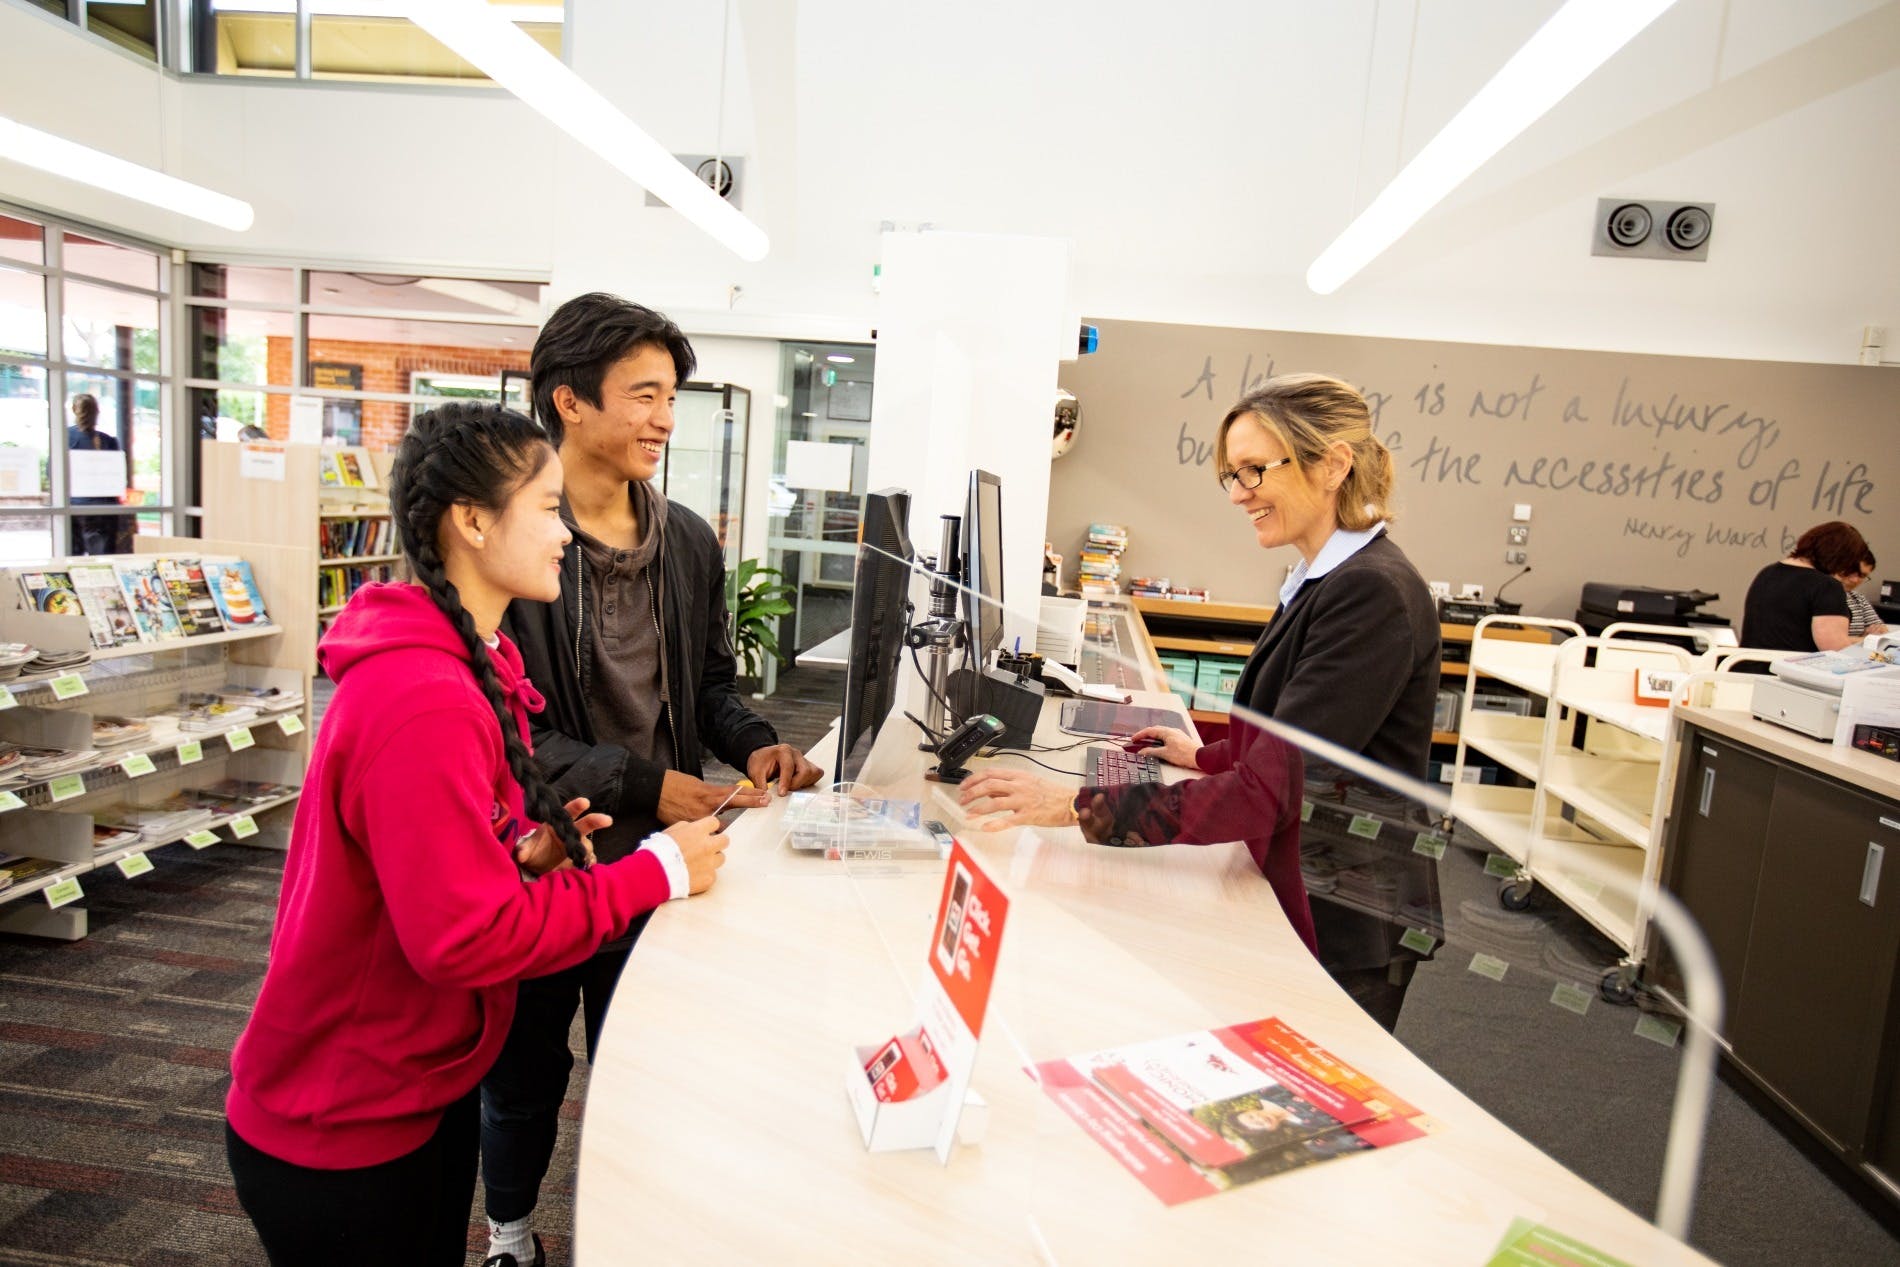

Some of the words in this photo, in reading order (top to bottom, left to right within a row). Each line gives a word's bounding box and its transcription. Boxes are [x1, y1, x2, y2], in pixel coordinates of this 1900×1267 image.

[1180, 355, 1217, 401] A
[1413, 364, 1446, 416] is
[1468, 373, 1546, 422] not
[1562, 396, 1589, 424] a
[1612, 375, 1781, 470] luxury,
[1176, 421, 1215, 467] bu
[1410, 435, 1482, 485] the
[1503, 447, 1725, 504] necessities
[1749, 458, 1801, 511] of
[1811, 459, 1876, 517] life
[1622, 517, 1697, 558] Henry
[1705, 522, 1769, 550] Ward
[845, 849, 892, 861] LEWIS
